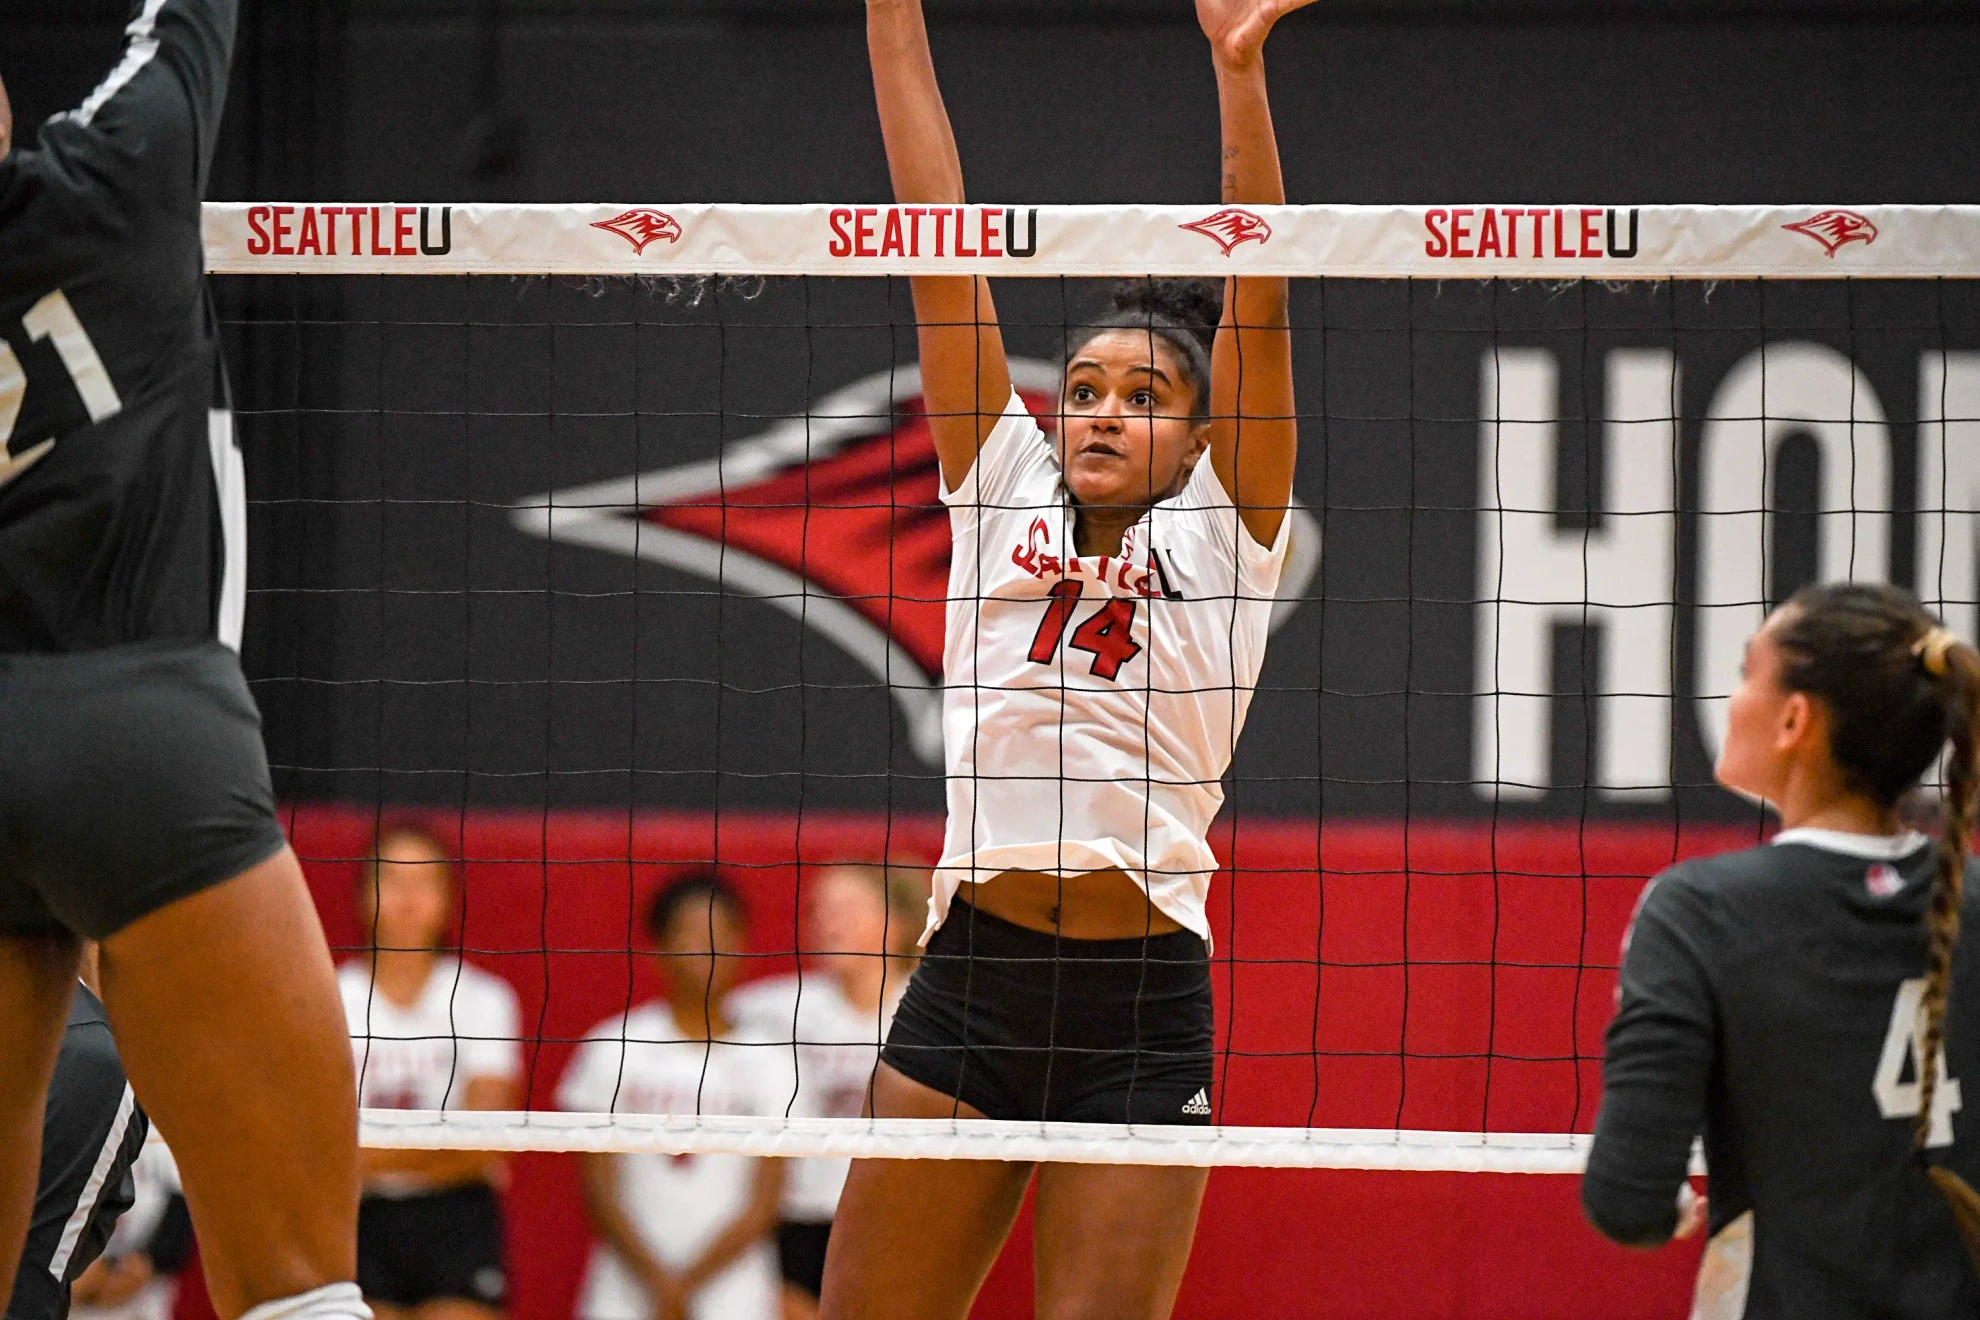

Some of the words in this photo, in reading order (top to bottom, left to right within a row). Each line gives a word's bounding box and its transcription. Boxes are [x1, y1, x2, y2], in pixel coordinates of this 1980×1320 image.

[247, 206, 452, 256] SEATTLEU
[829, 207, 1038, 257] SEATTLEU
[1425, 208, 1639, 258] SEATTLEU
[1027, 578, 1142, 682] 14
[1872, 978, 1963, 1148] 4
